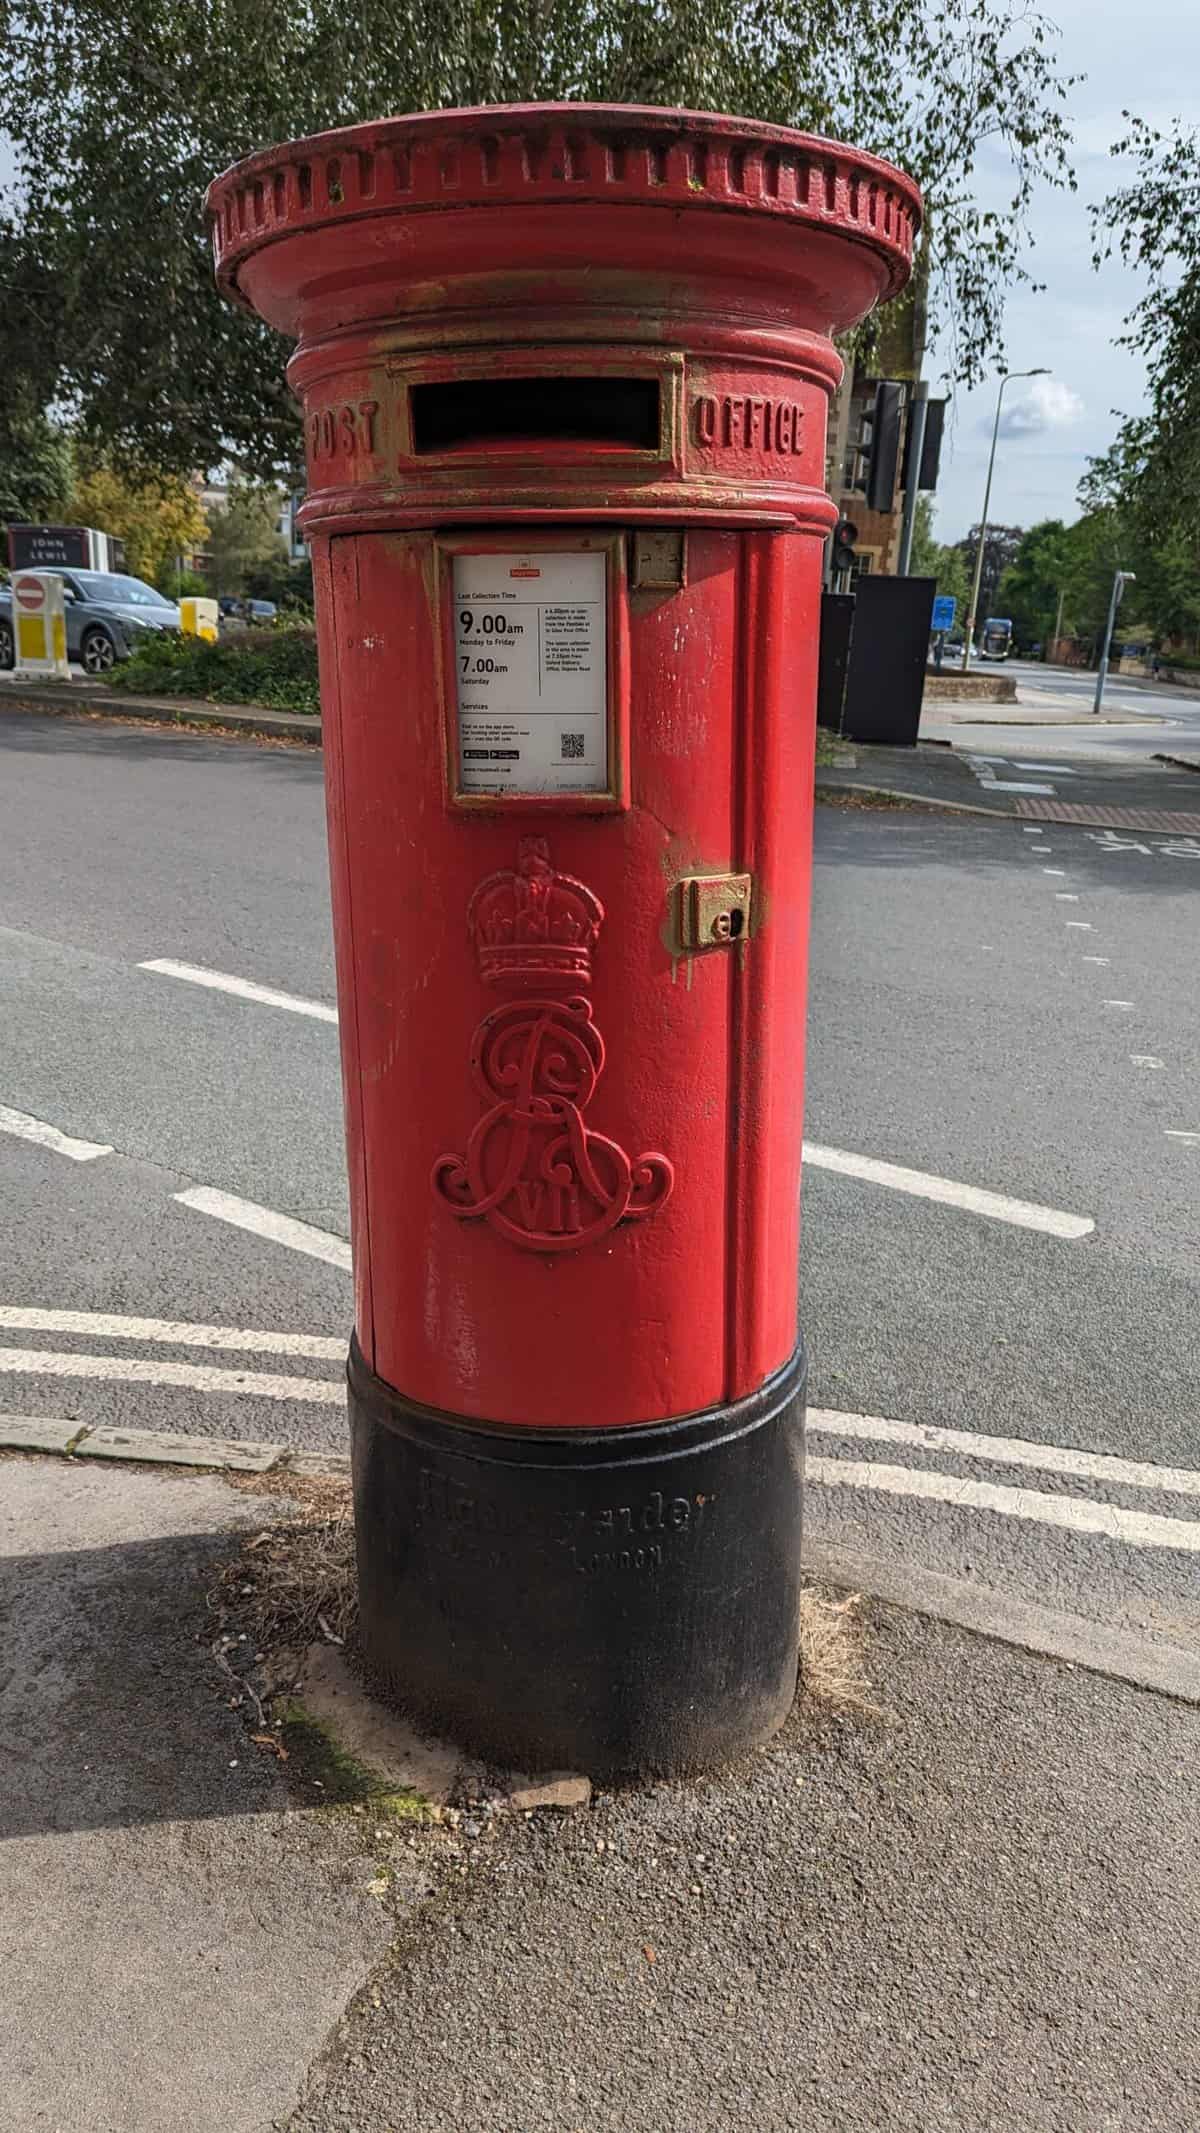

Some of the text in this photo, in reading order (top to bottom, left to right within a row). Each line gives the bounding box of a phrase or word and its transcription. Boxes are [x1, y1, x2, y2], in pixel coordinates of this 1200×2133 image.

[307, 400, 378, 459] POST
[695, 395, 804, 455] OFFICE
[32, 538, 65, 548] JOHN
[30, 551, 68, 561] LEWIS
[459, 610, 524, 634] 9.00am
[459, 639, 485, 647] Monday
[494, 639, 516, 647] Friday
[460, 655, 508, 673] 7.00am
[461, 677, 490, 685] Saturday
[461, 702, 489, 710] Services
